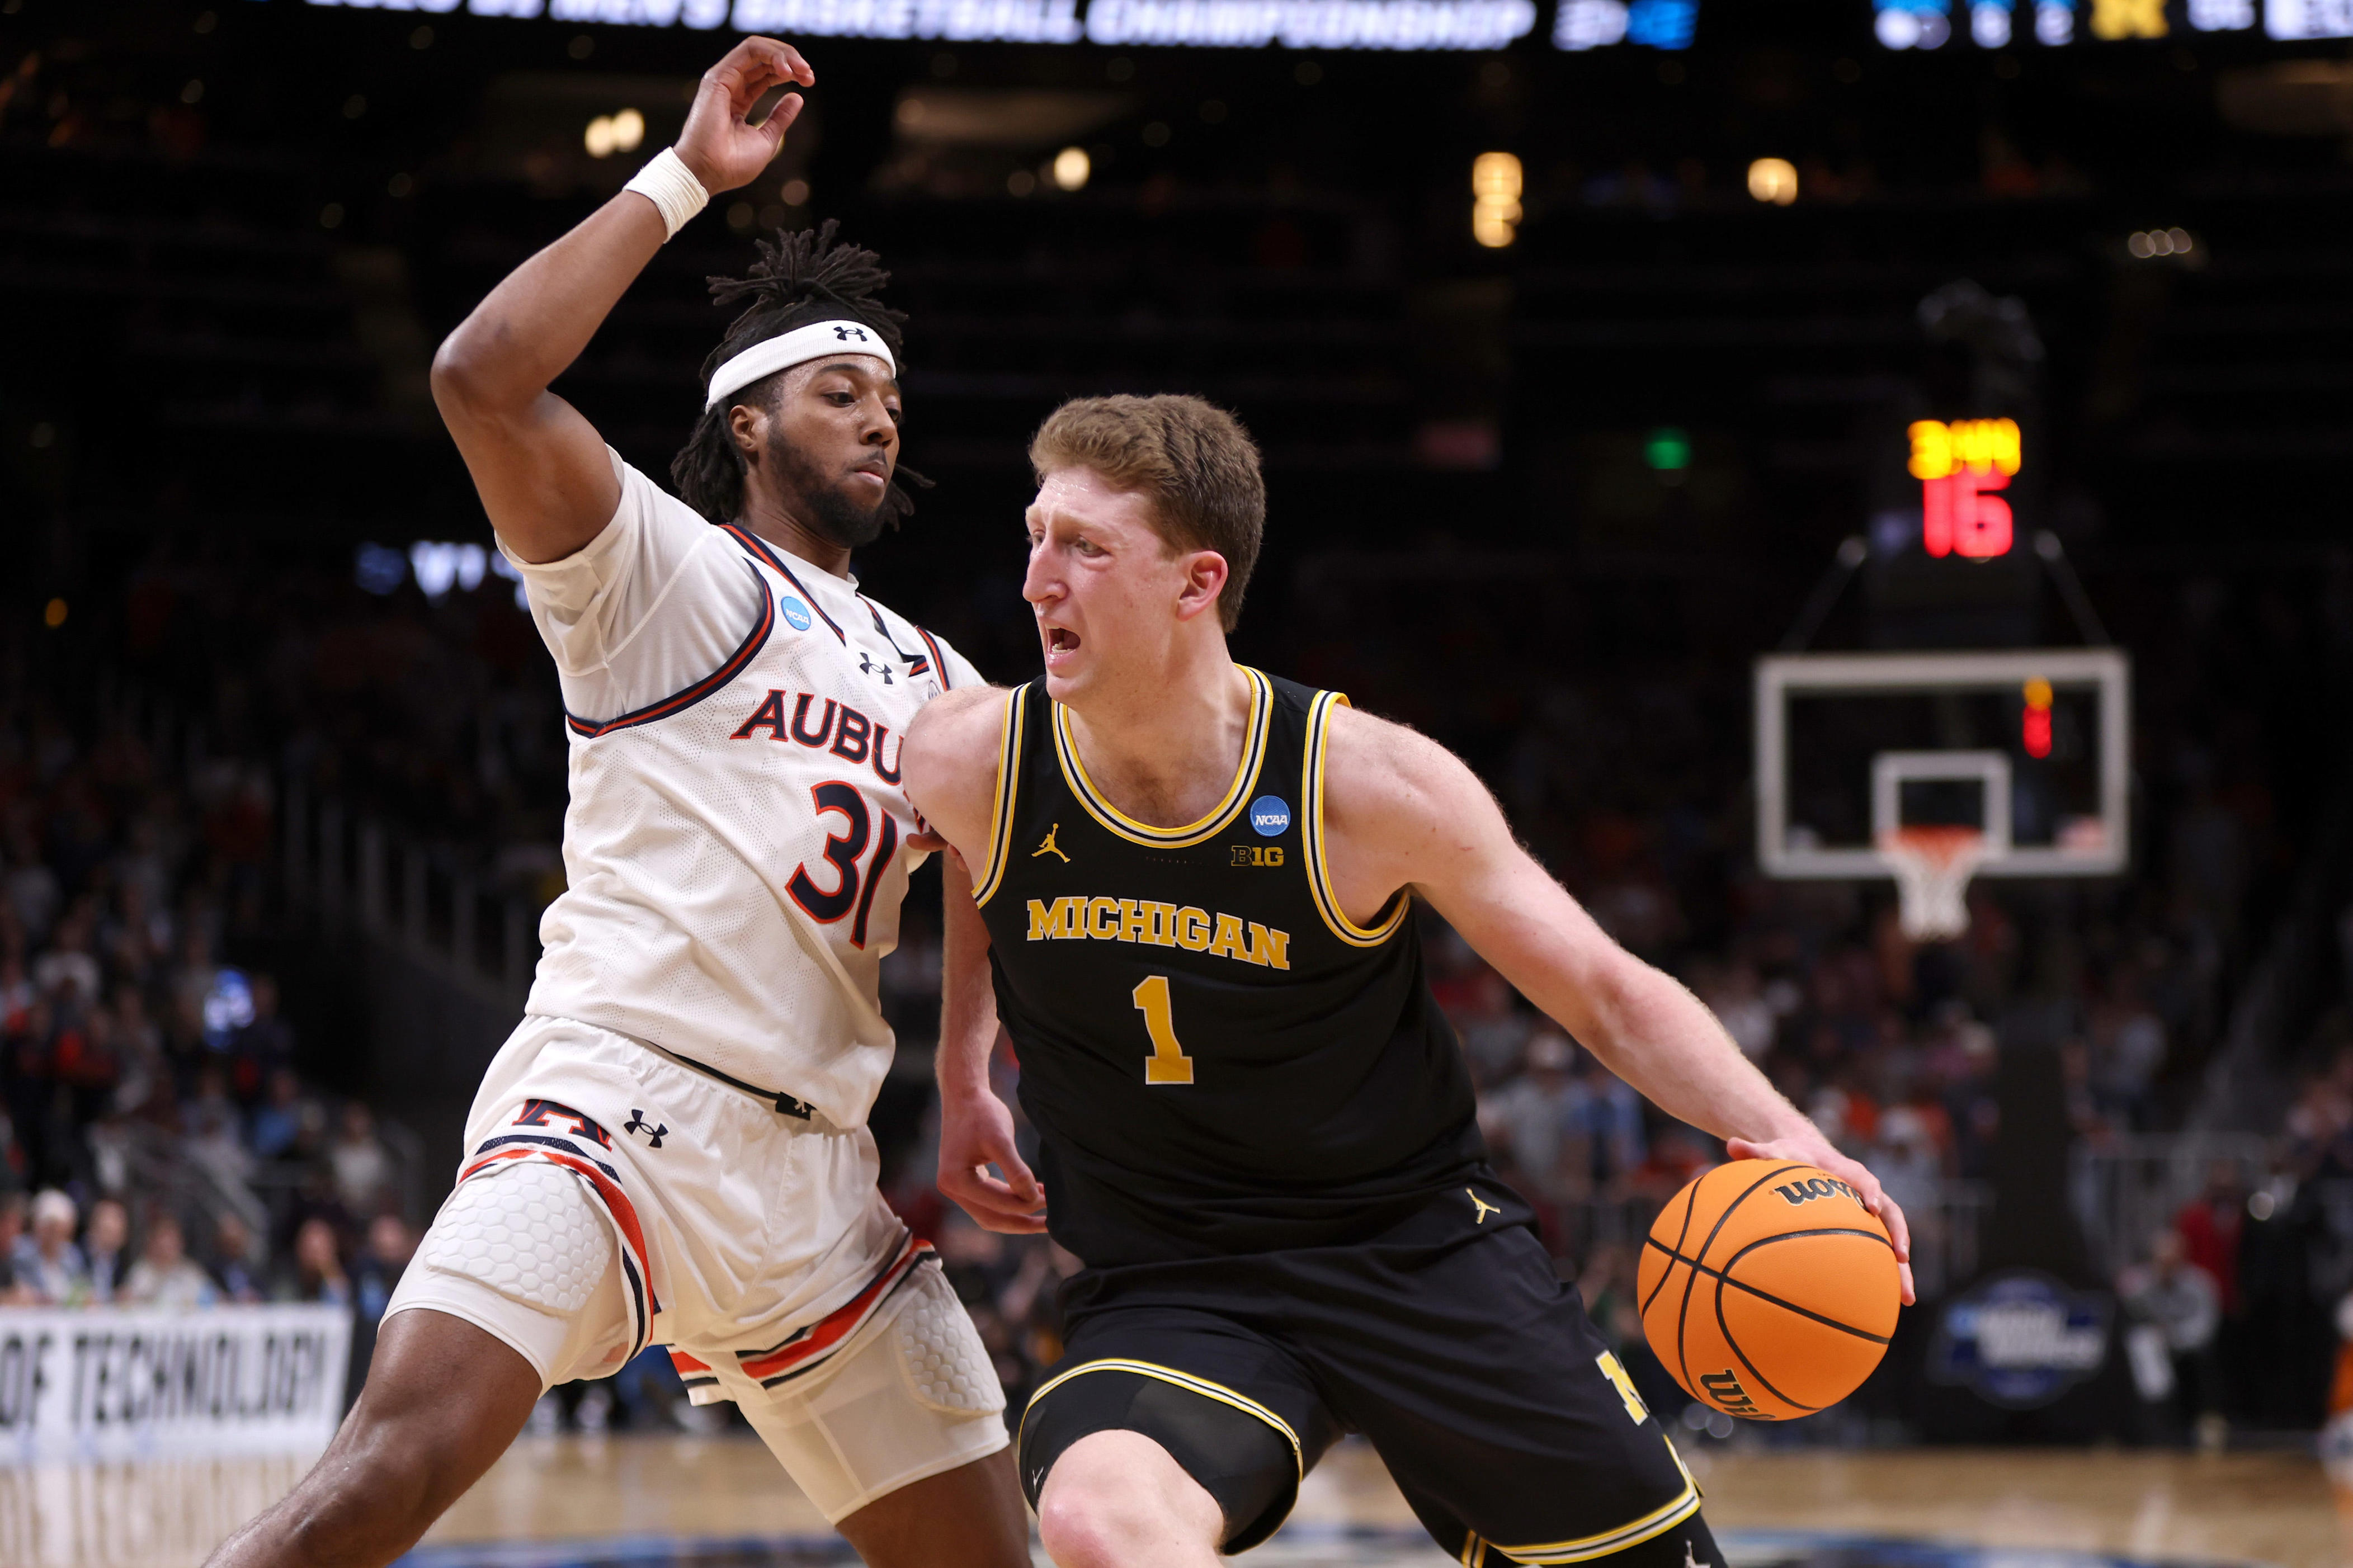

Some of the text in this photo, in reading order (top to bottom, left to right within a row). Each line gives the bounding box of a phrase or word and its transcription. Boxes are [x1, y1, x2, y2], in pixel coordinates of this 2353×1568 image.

[786, 608, 810, 625] NCAA
[729, 689, 905, 786] AUBU
[1255, 814, 1288, 826] NCAA
[785, 780, 898, 951] 31
[1027, 896, 1290, 971] MICHIGAN
[1132, 975, 1195, 1085] 1
